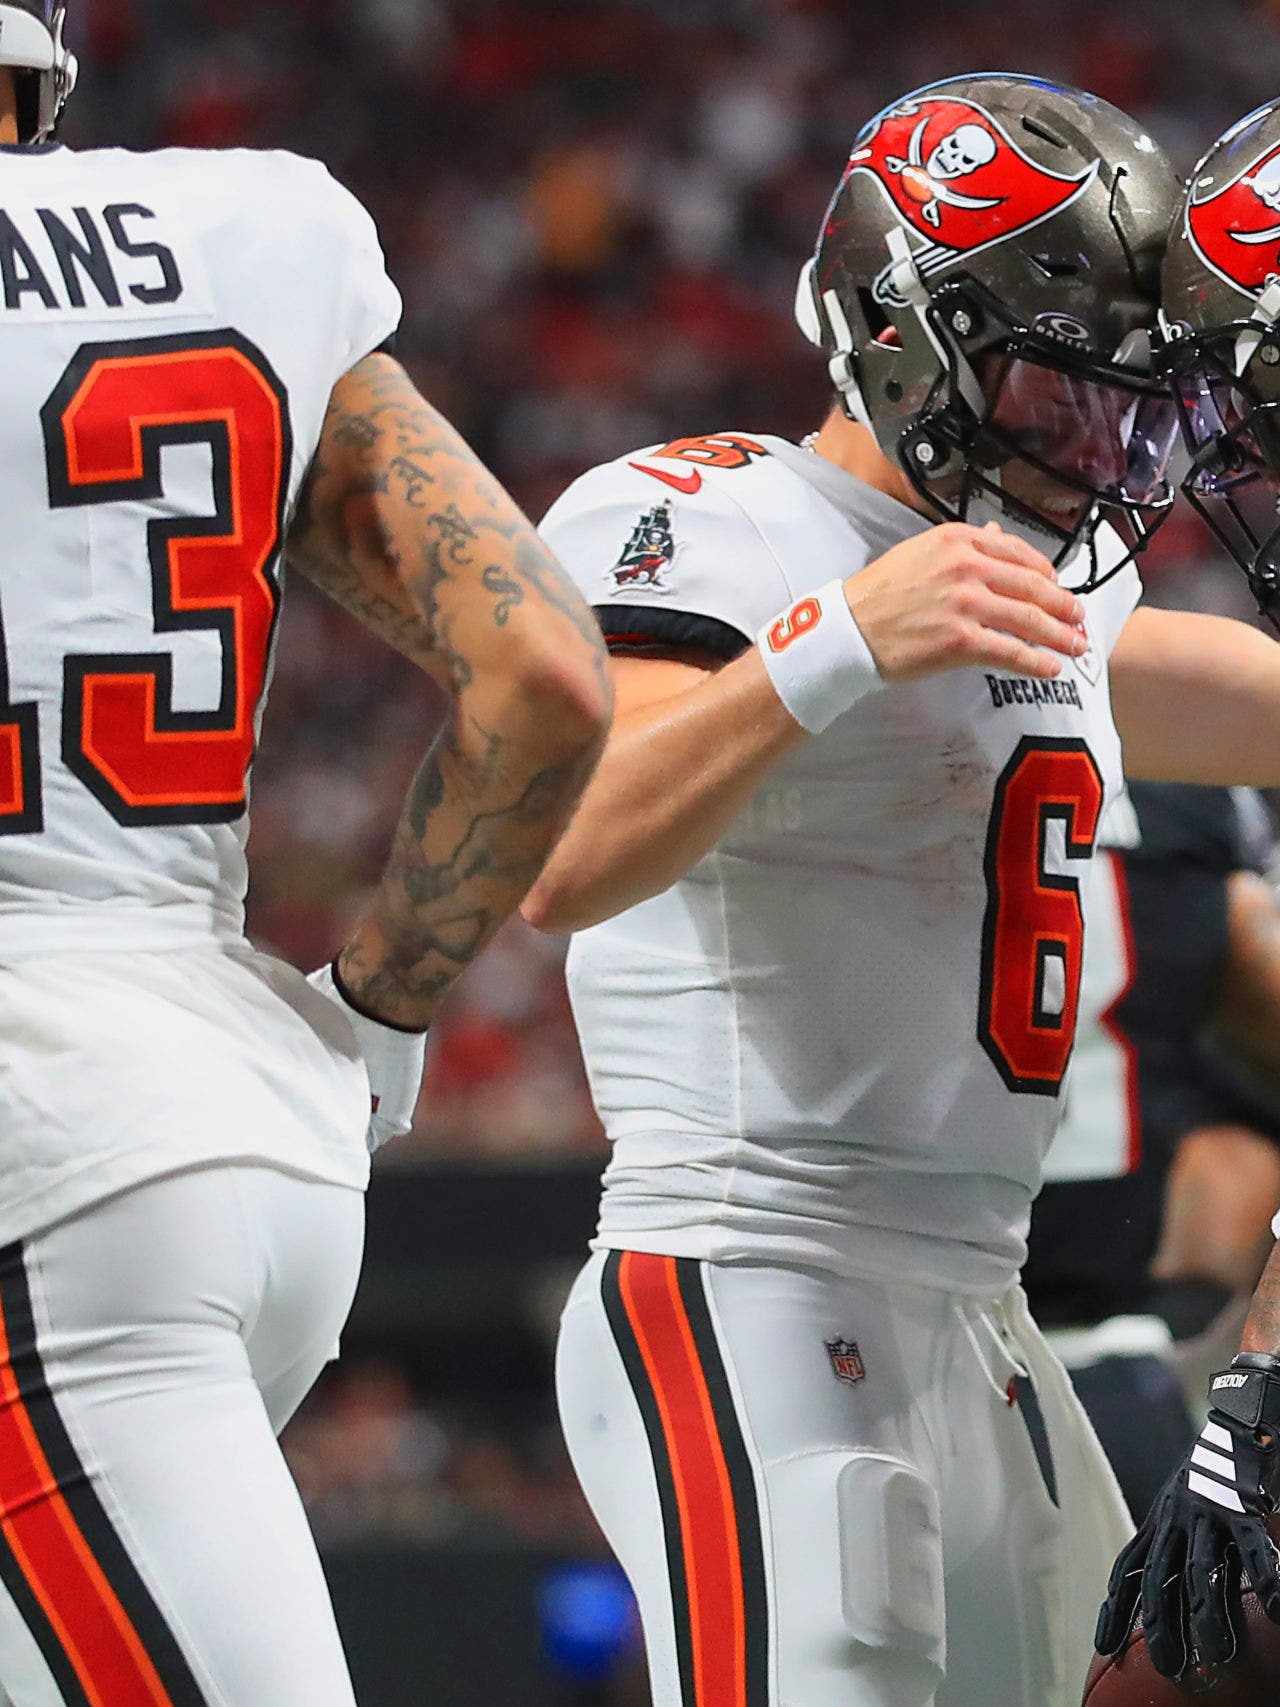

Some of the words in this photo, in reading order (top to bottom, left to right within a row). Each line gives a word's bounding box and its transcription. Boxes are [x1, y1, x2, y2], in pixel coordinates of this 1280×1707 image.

[0, 203, 183, 309] ANS
[0, 327, 293, 833] 3
[977, 735, 1103, 1096] 6
